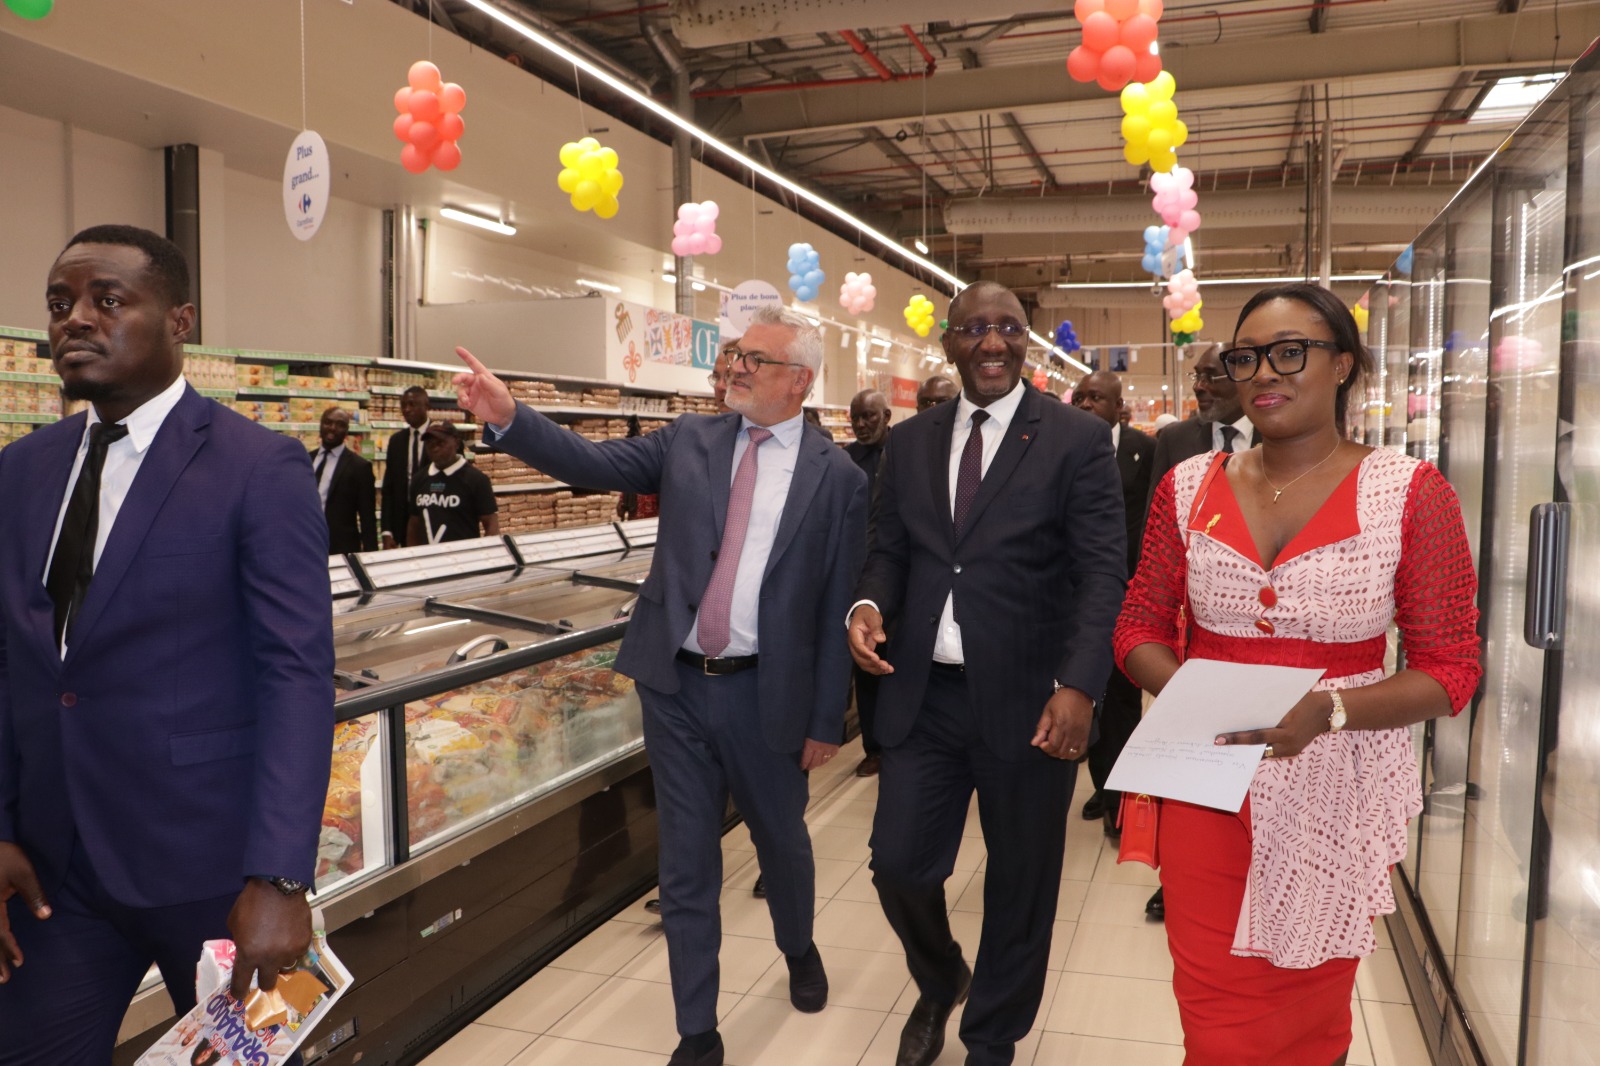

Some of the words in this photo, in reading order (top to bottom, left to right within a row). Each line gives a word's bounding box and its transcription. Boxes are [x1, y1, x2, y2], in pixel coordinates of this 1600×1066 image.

[296, 146, 313, 160] Plus
[416, 493, 460, 508] GRAND
[206, 994, 270, 1066] GRAAAND
[209, 1032, 230, 1057] PLUS
